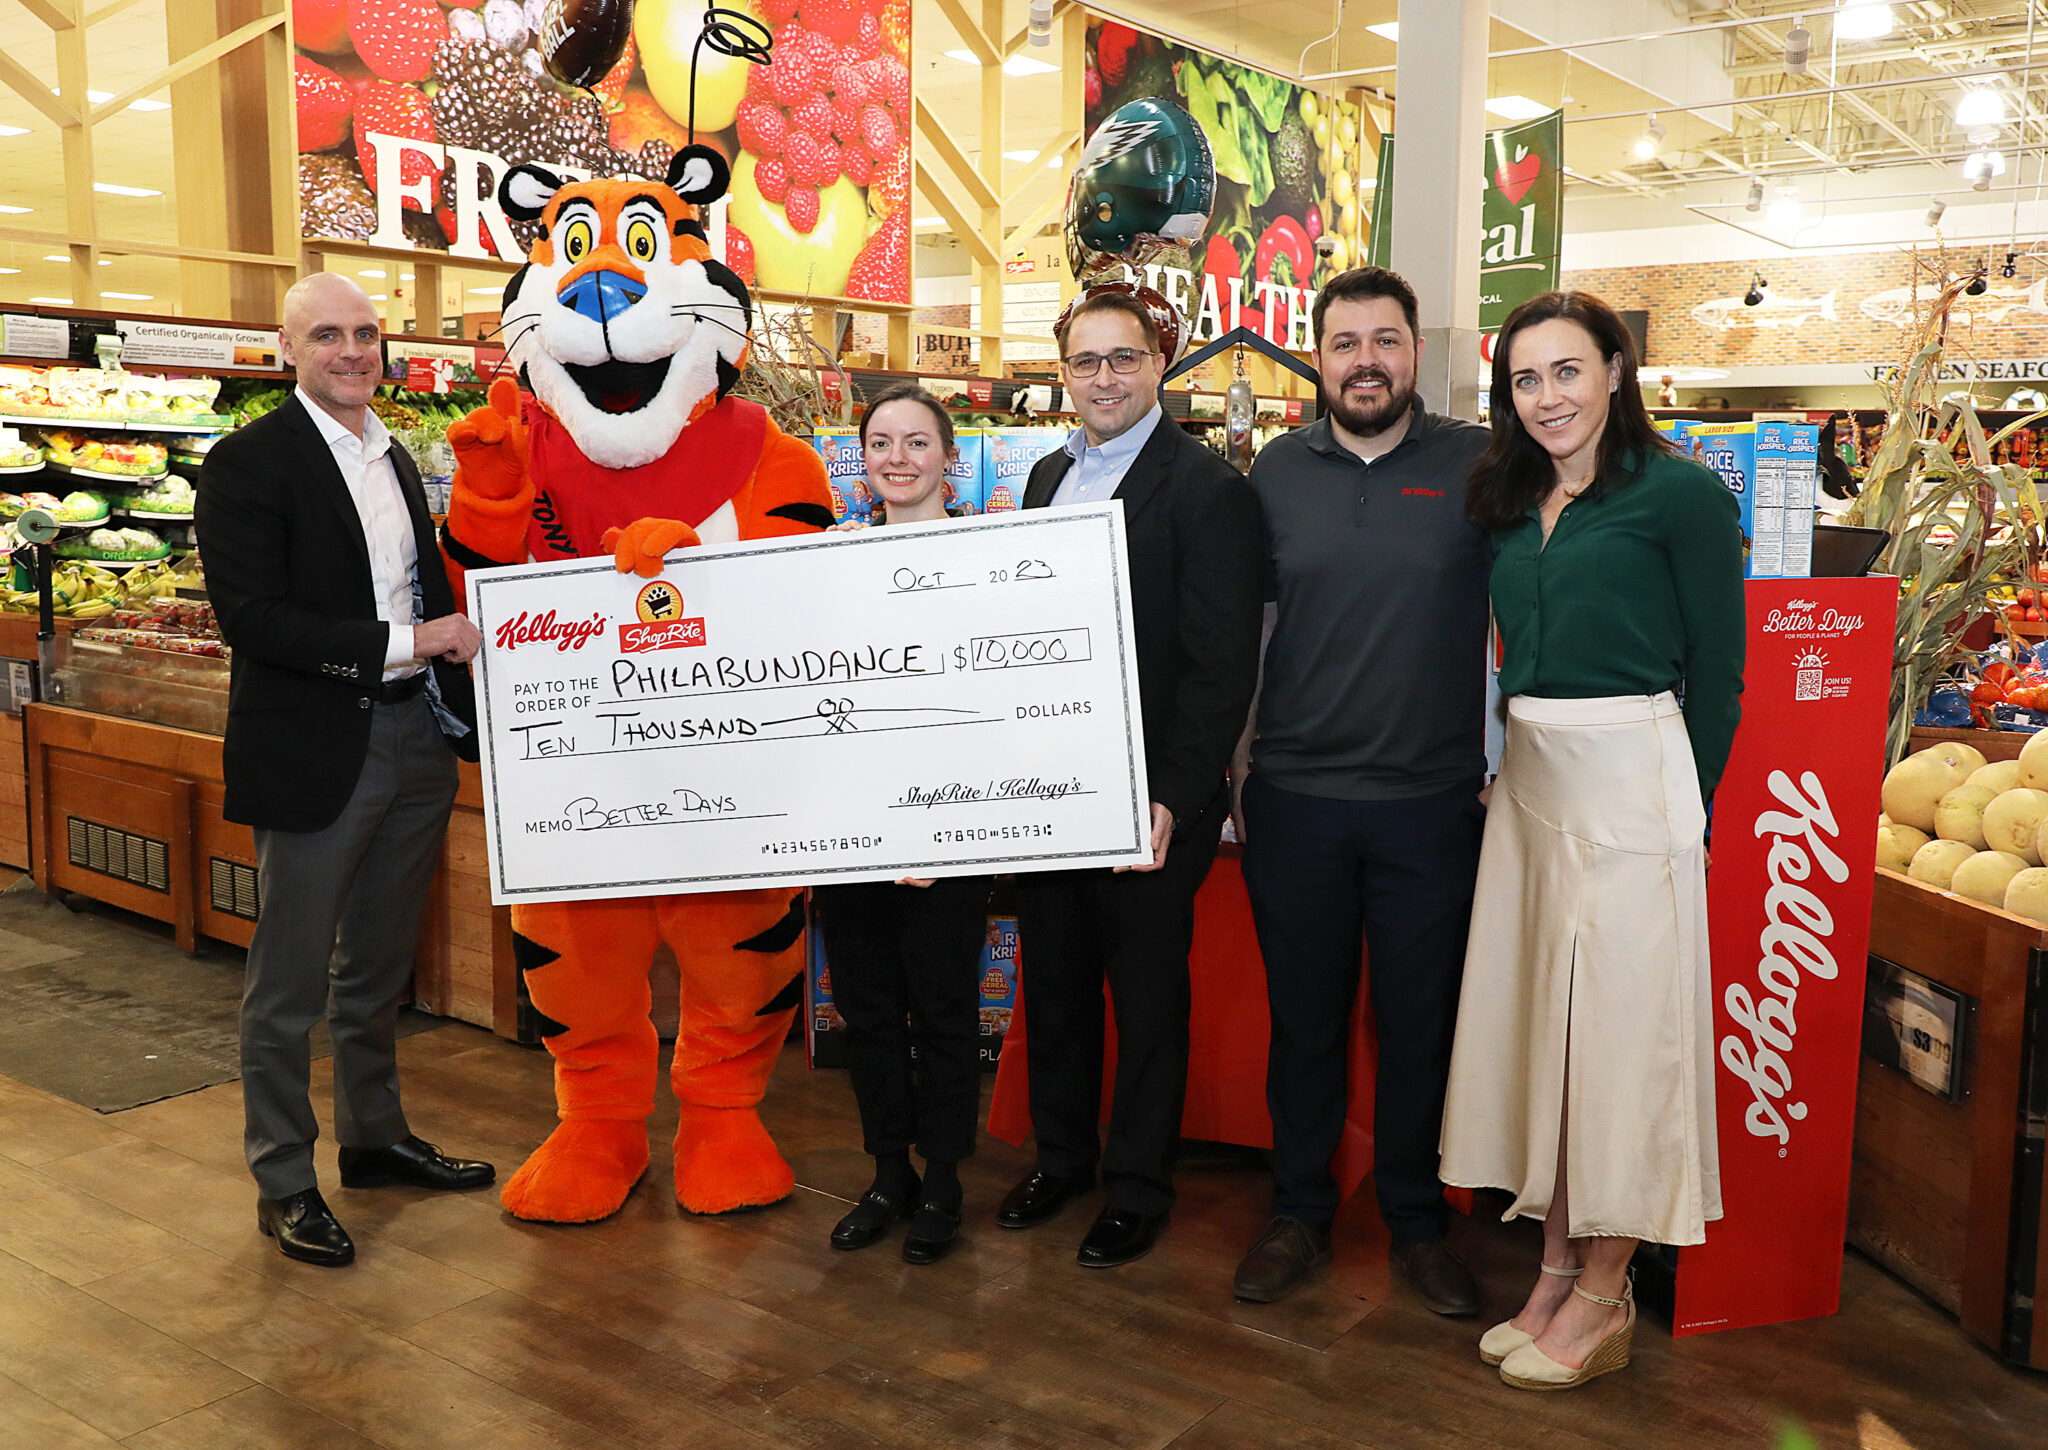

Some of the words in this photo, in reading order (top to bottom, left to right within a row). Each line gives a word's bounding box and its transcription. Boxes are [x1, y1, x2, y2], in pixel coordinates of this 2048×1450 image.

[540, 15, 576, 63] BALL
[136, 326, 178, 338] Certified
[180, 329, 234, 343] Organically
[235, 333, 266, 344] Grown
[1764, 435, 1781, 443] RICE
[1793, 437, 1810, 446] RICE
[1705, 451, 1734, 471] RICE
[532, 490, 578, 553] TONY
[989, 569, 1008, 584] 20
[1015, 559, 1055, 580] 23
[495, 608, 607, 651] Kellogg's
[1762, 608, 1816, 633] Better
[1817, 608, 1865, 637] Days
[624, 620, 702, 651] ShopRite
[1821, 631, 1841, 639] PLANET
[611, 645, 927, 698] PHILABUNDANCE
[1823, 677, 1840, 685] JOIN
[1840, 677, 1852, 685] US!
[513, 682, 541, 696] PAY
[545, 680, 565, 694] TO
[569, 677, 599, 691] THE
[515, 697, 569, 714] ORDER
[572, 695, 591, 709] OF
[1015, 702, 1092, 720] DOLLARS
[509, 720, 577, 760] TEN
[595, 712, 758, 747] THOUSAND
[898, 781, 983, 809] ShopRite
[997, 776, 1084, 801] Kellogg's
[525, 819, 573, 835] MEMO
[1719, 769, 1850, 1145] Kellogg's
